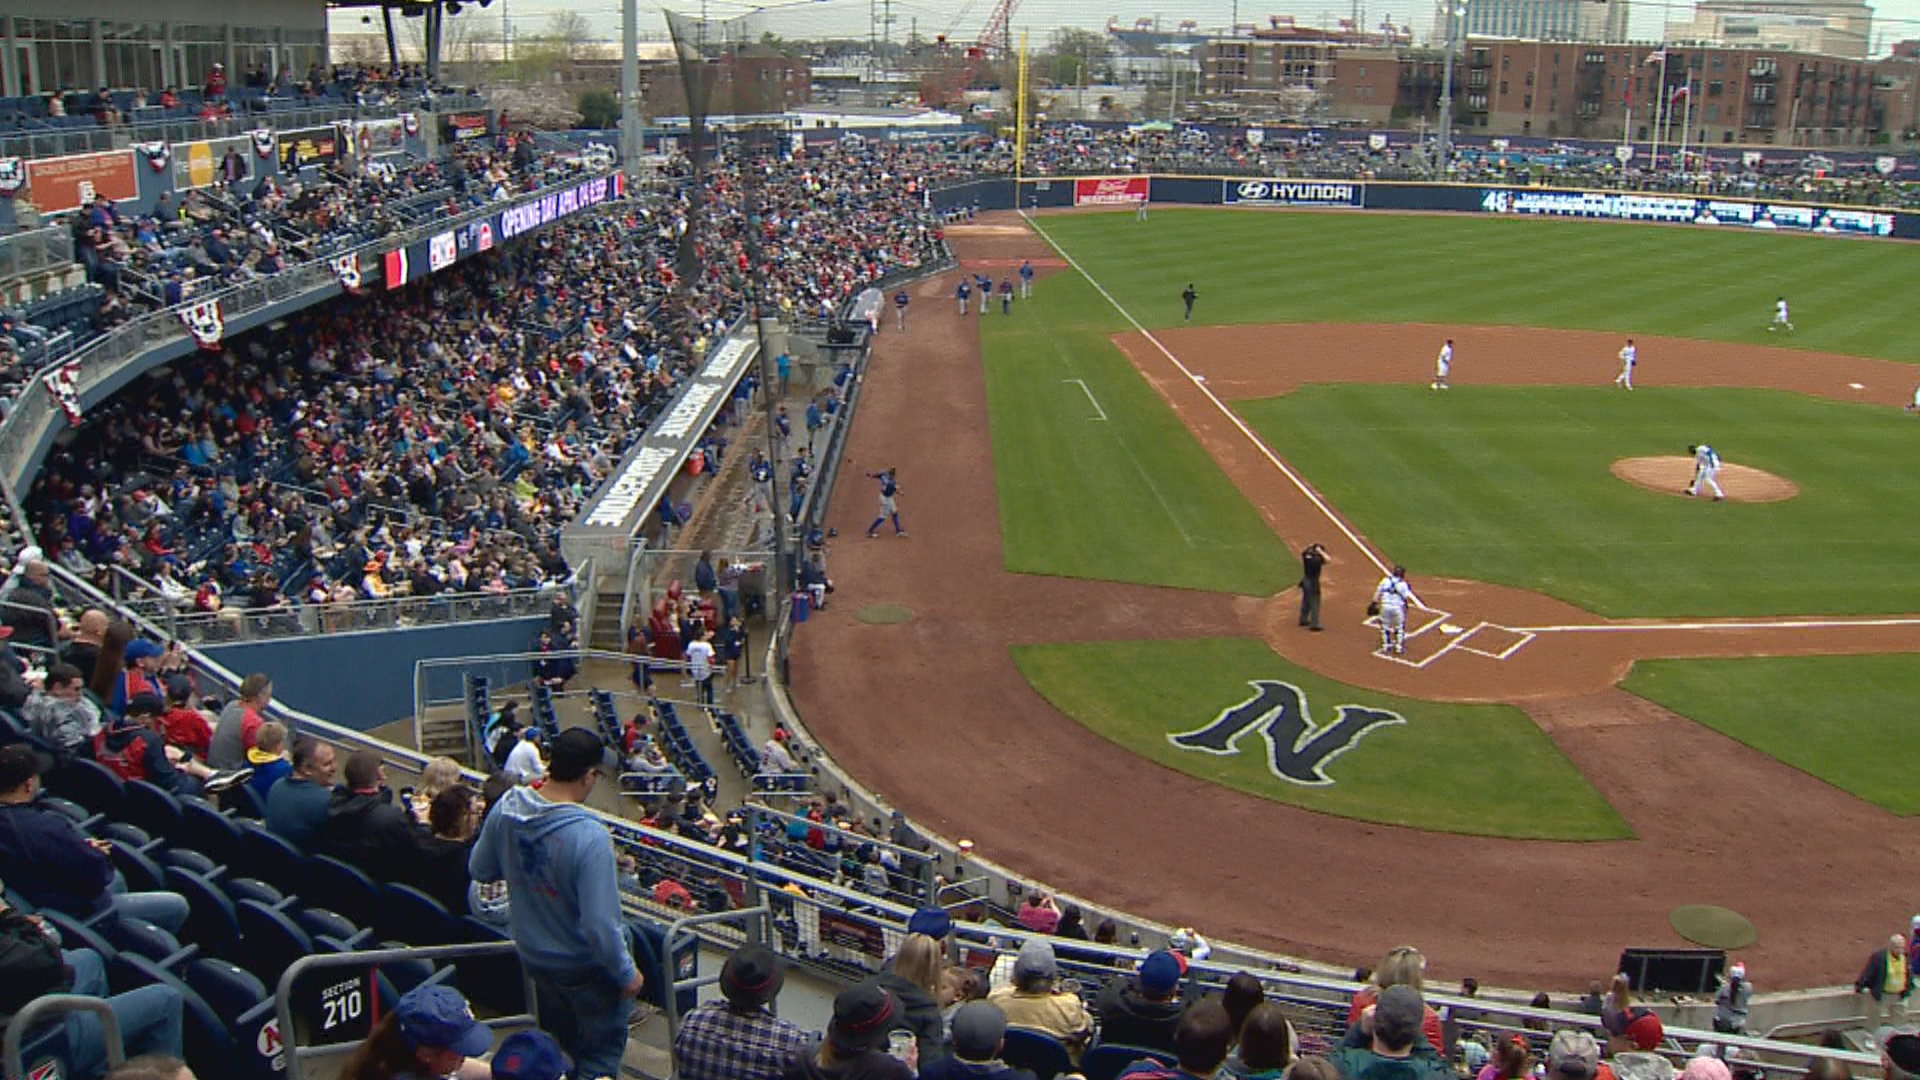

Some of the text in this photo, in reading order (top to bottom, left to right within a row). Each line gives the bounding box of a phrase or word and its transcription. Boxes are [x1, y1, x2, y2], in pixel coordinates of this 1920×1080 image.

[1271, 183, 1353, 200] HYUNDAI
[1481, 190, 1508, 213] 46
[501, 199, 541, 240] OPENING
[541, 193, 558, 224] DAY
[559, 187, 579, 216] APRIL
[1166, 679, 1408, 786] N
[321, 976, 361, 1000] SECTION
[322, 990, 363, 1030] 210
